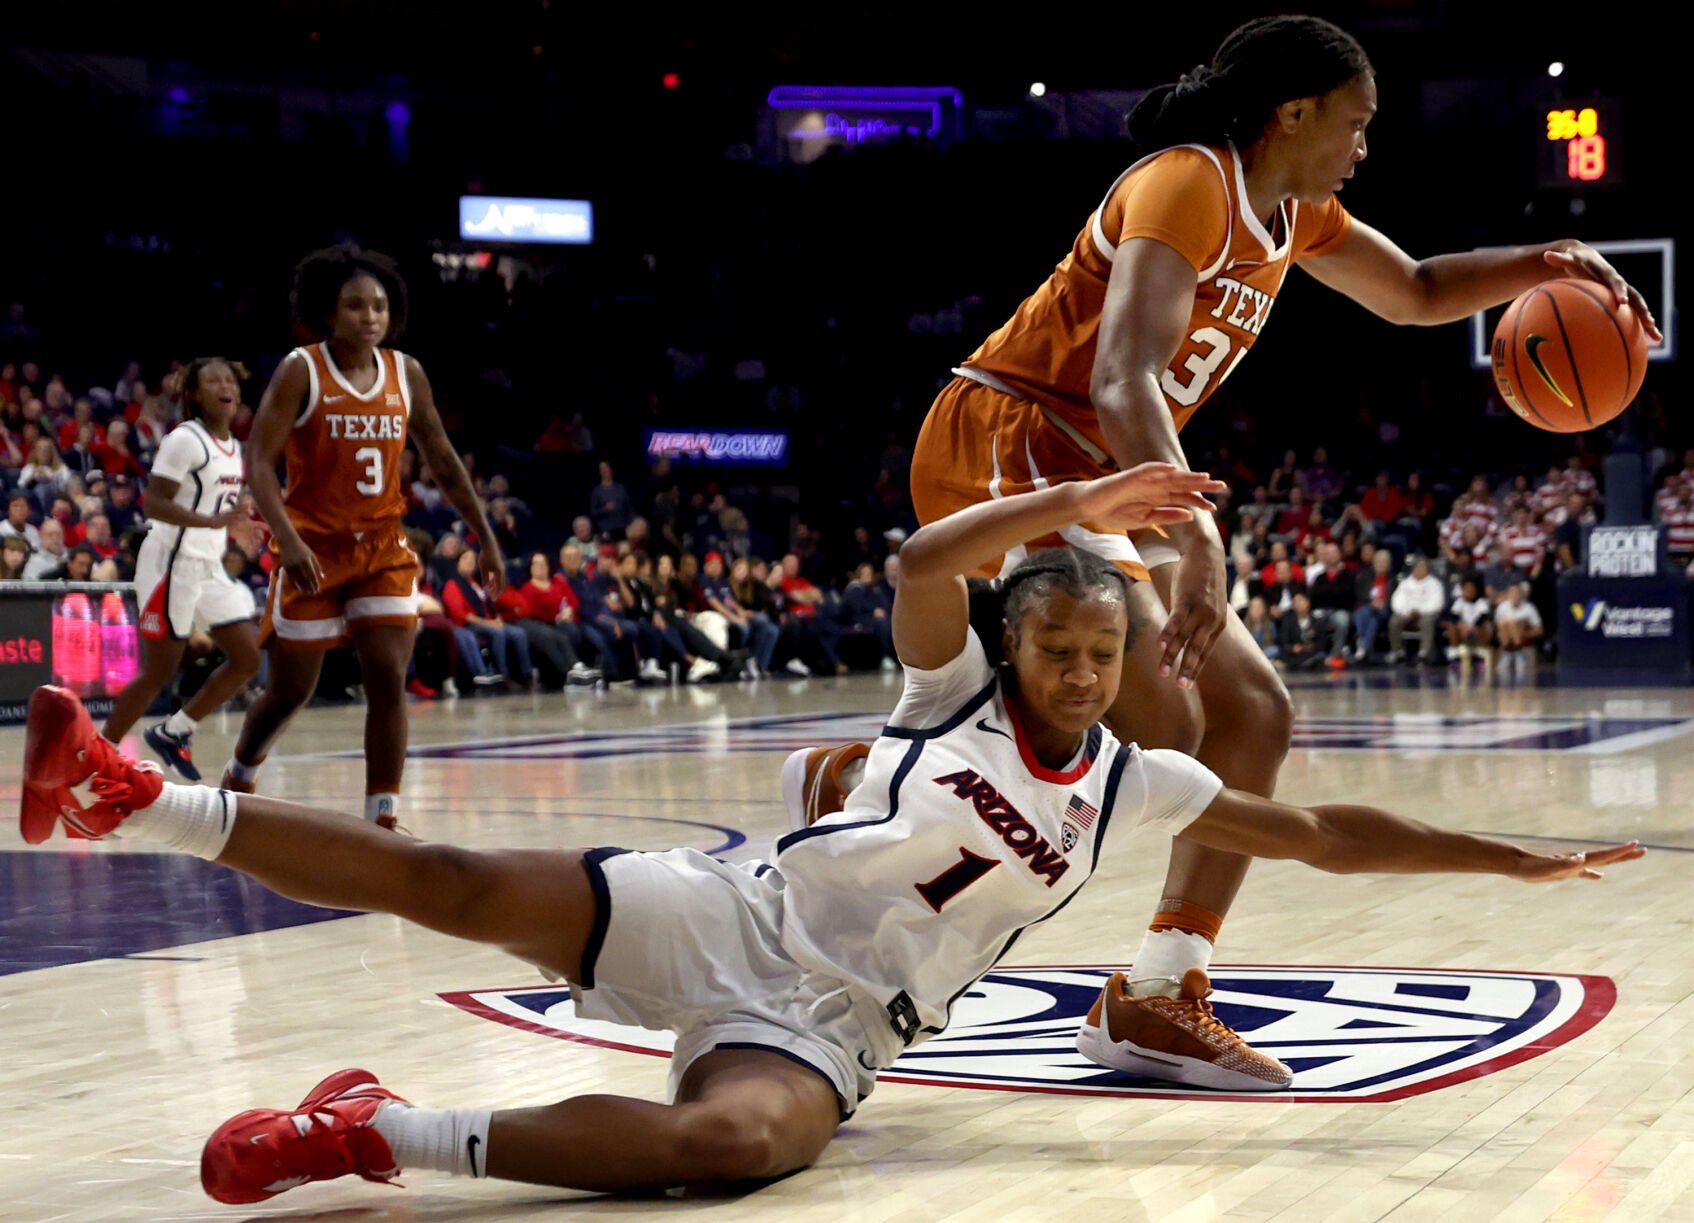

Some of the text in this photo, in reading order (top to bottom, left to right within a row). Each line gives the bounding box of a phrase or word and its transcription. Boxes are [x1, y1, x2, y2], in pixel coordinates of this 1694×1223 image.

[1568, 134, 1605, 180] 18
[1160, 326, 1248, 406] 3
[325, 414, 403, 439] TEXAS
[355, 447, 384, 496] 3
[932, 768, 1070, 888] ARIZONA
[914, 846, 1002, 913] 1
